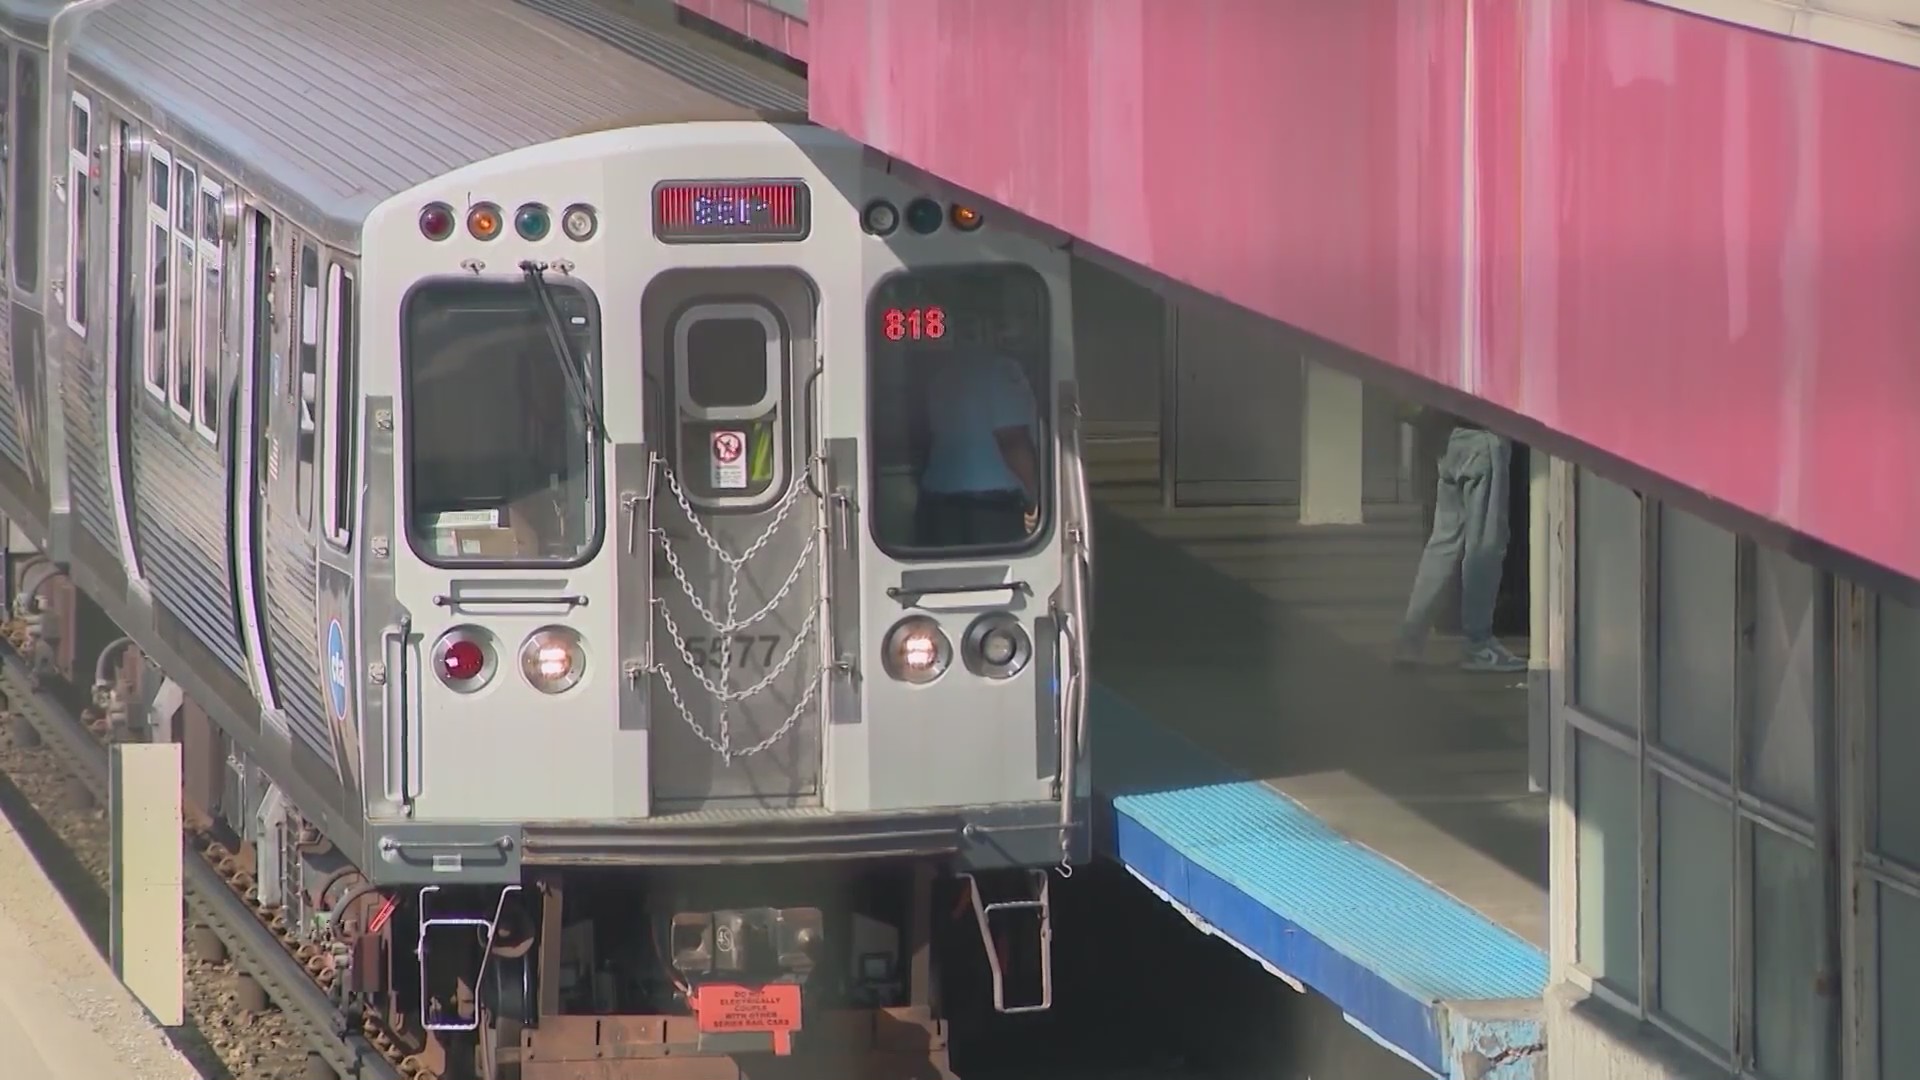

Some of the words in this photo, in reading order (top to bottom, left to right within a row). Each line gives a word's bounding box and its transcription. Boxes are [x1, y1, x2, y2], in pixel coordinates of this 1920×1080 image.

[885, 308, 945, 340] 818
[686, 635, 780, 669] 5577
[734, 990, 747, 998] DO
[720, 997, 781, 1006] ELECTRICALLY
[749, 1011, 777, 1019] OTHER
[713, 1020, 743, 1028] SERIES
